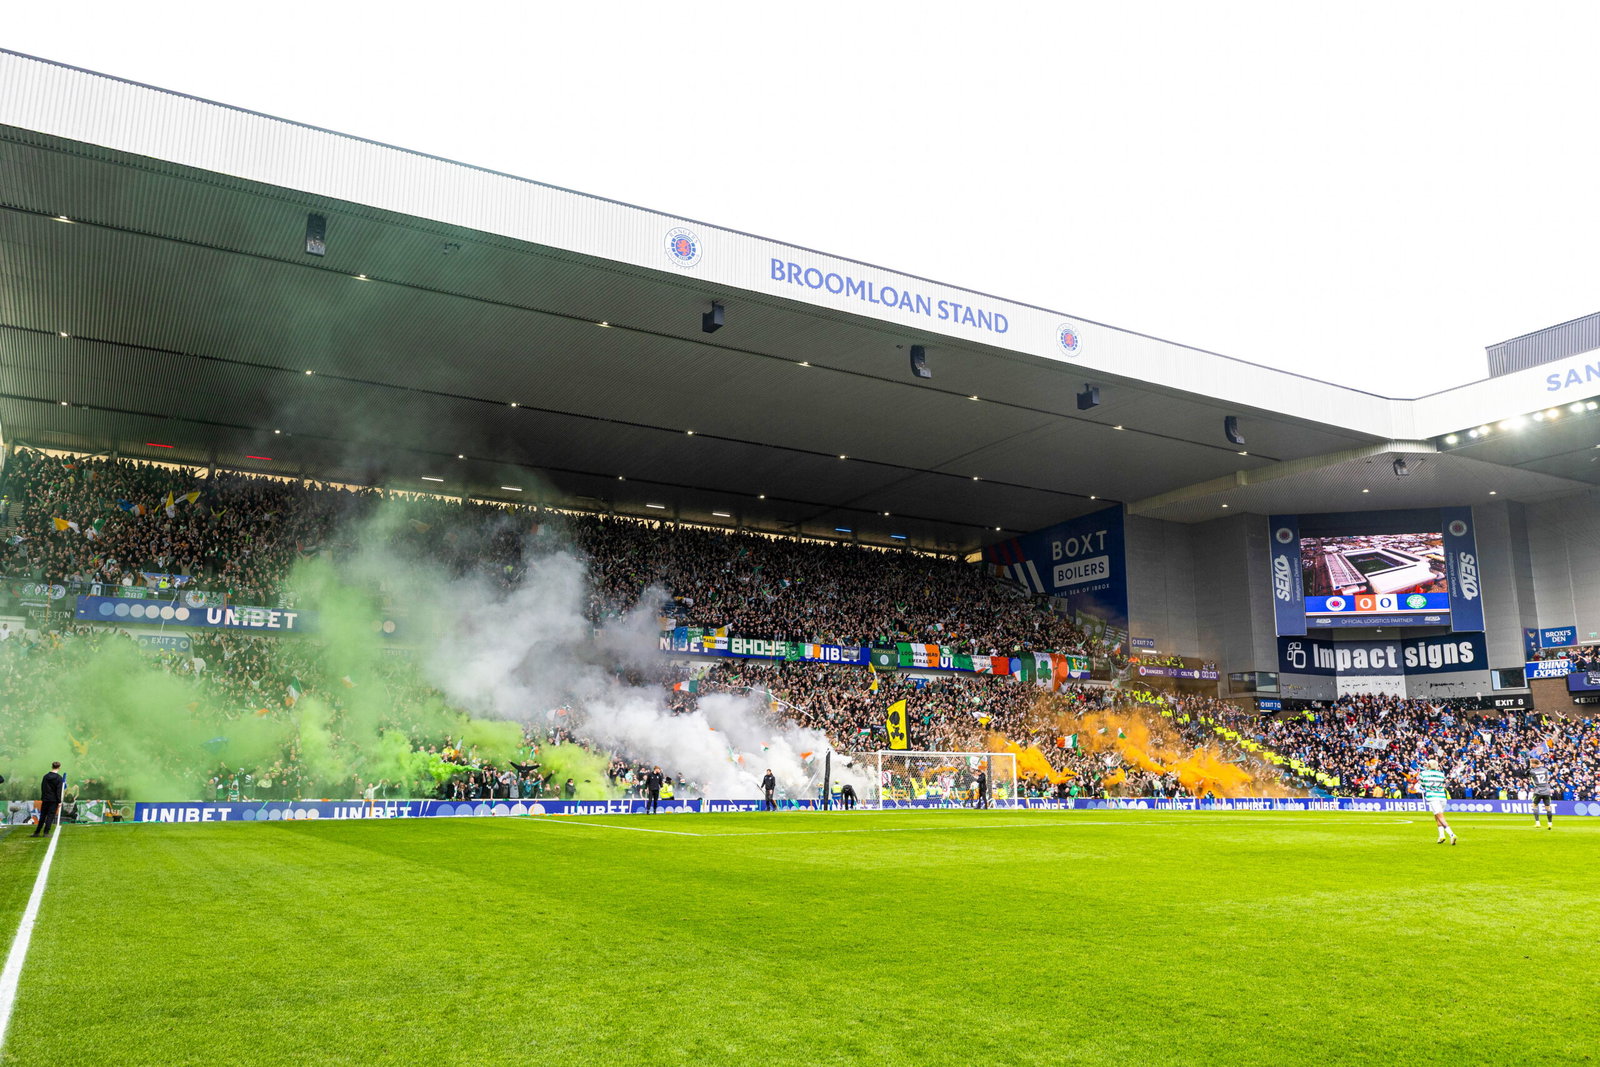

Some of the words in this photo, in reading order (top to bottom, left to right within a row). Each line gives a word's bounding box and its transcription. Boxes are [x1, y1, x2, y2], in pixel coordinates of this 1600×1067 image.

[770, 258, 931, 316] BROOMLOAN
[938, 300, 1009, 334] STAND
[1052, 530, 1107, 561] BOXT
[1058, 562, 1105, 581] BOILERS
[1460, 552, 1478, 600] SEKO
[1274, 555, 1291, 601] SEKO
[1092, 583, 1110, 591] IBROX
[1359, 598, 1372, 609] 0
[1380, 598, 1391, 608] 0
[1545, 630, 1572, 638] BROXI'S
[731, 638, 786, 656] BHOYS
[804, 647, 857, 662] NIB
[1313, 643, 1397, 671] Impact
[1405, 641, 1474, 669] signs
[1538, 661, 1568, 670] RHINO
[1201, 670, 1216, 679] 00:00
[1533, 668, 1571, 678] EXPRES
[1495, 699, 1514, 707] EXIT
[1535, 774, 1546, 783] 12
[563, 805, 629, 814] UNIBET
[1308, 801, 1340, 811] UNIBET
[142, 807, 232, 822] UNIBET
[333, 806, 412, 818] UNIBET
